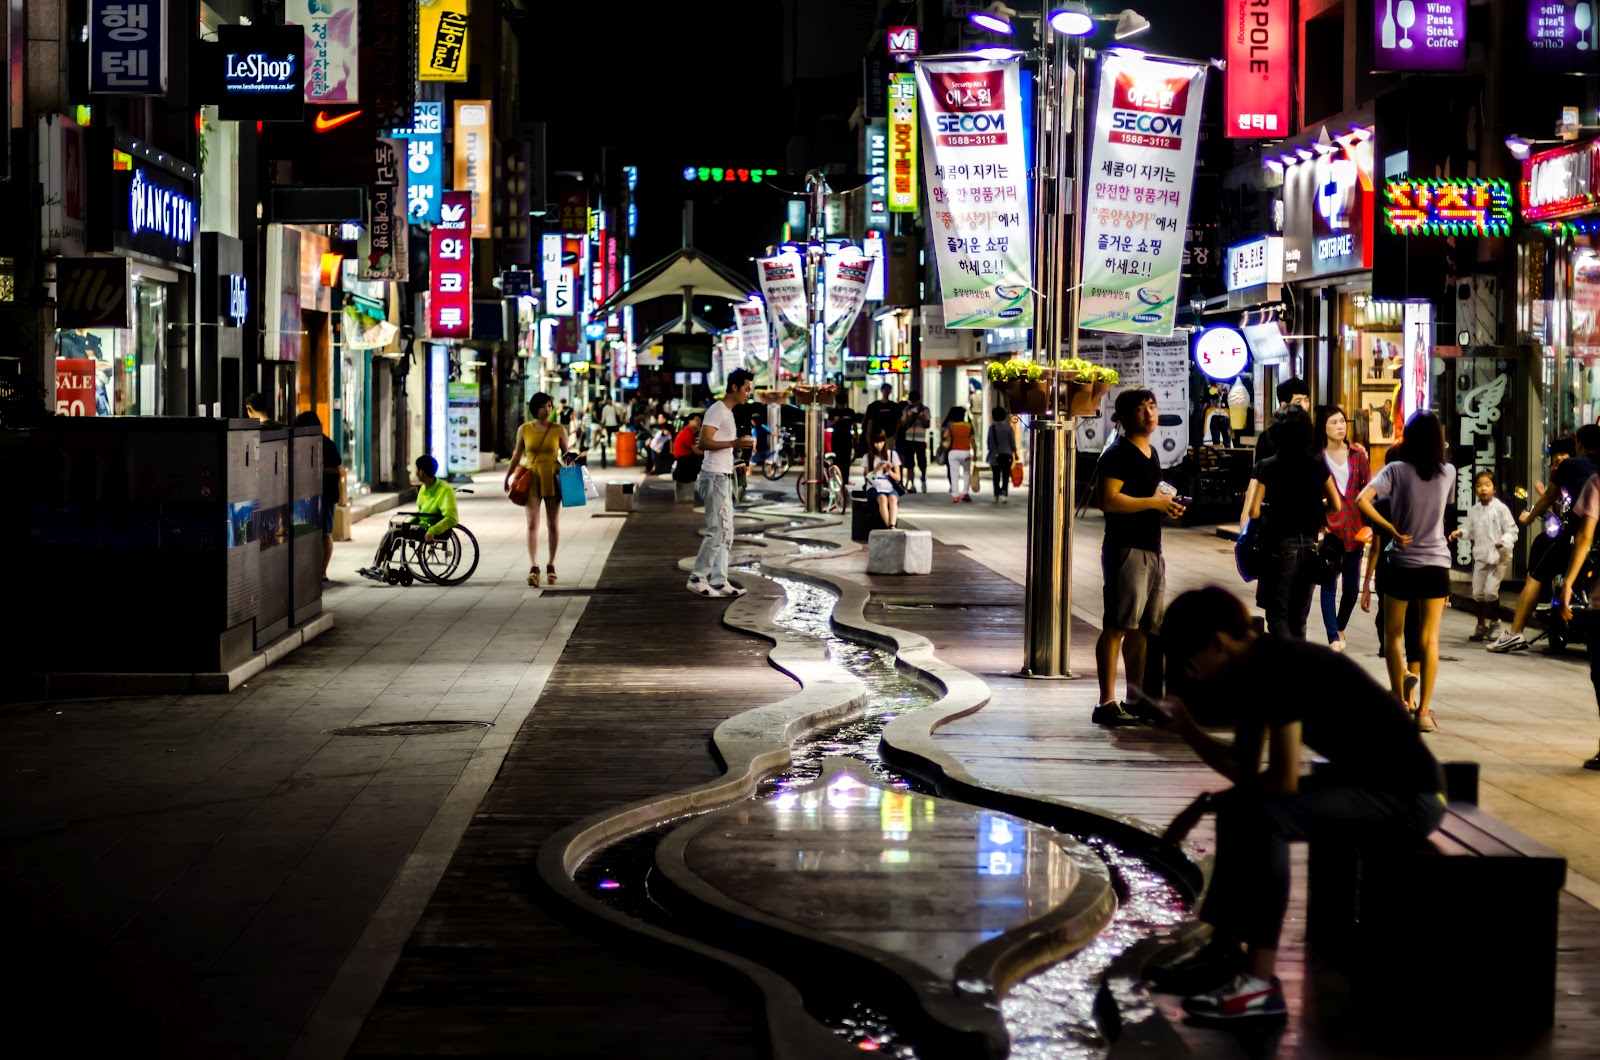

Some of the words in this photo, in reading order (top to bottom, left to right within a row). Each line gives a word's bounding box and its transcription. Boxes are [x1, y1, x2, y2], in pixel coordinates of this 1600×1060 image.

[1427, 3, 1451, 13] Wine
[1237, 0, 1247, 45] Technology
[1427, 14, 1453, 25] Pasta
[1427, 26, 1454, 36] Steak
[101, 4, 149, 86] 행텐
[1427, 37, 1458, 48] Coffee
[312, 23, 330, 95] 청십자치과
[227, 54, 291, 82] LeShop
[891, 84, 914, 99] 그린
[946, 88, 992, 107] 에스원
[937, 114, 1005, 132] SECOM
[1113, 112, 1182, 136] SECOM
[1238, 114, 1278, 130] 센터폴
[948, 135, 997, 145] 1588-3112
[1121, 134, 1170, 147] 1588-3112
[871, 135, 885, 197] MILLET
[935, 164, 969, 180] 세콤이
[973, 163, 1008, 179] 지키는
[1101, 161, 1137, 179] 세콤이
[1140, 165, 1176, 183] 지키는
[970, 186, 1017, 202] 명품거리
[1096, 183, 1130, 200] 안전한
[1133, 187, 1180, 206] 명품거리
[172, 196, 192, 242] TEN
[947, 237, 981, 253] 즐거운
[985, 236, 1008, 252] 쇼핑
[1098, 234, 1133, 252] 즐거운
[1136, 239, 1162, 256] 쇼핑
[766, 268, 794, 276] SECOM
[958, 260, 1004, 276] 하세요!!
[1105, 258, 1151, 277] 하세요!!
[57, 400, 85, 416] 50
